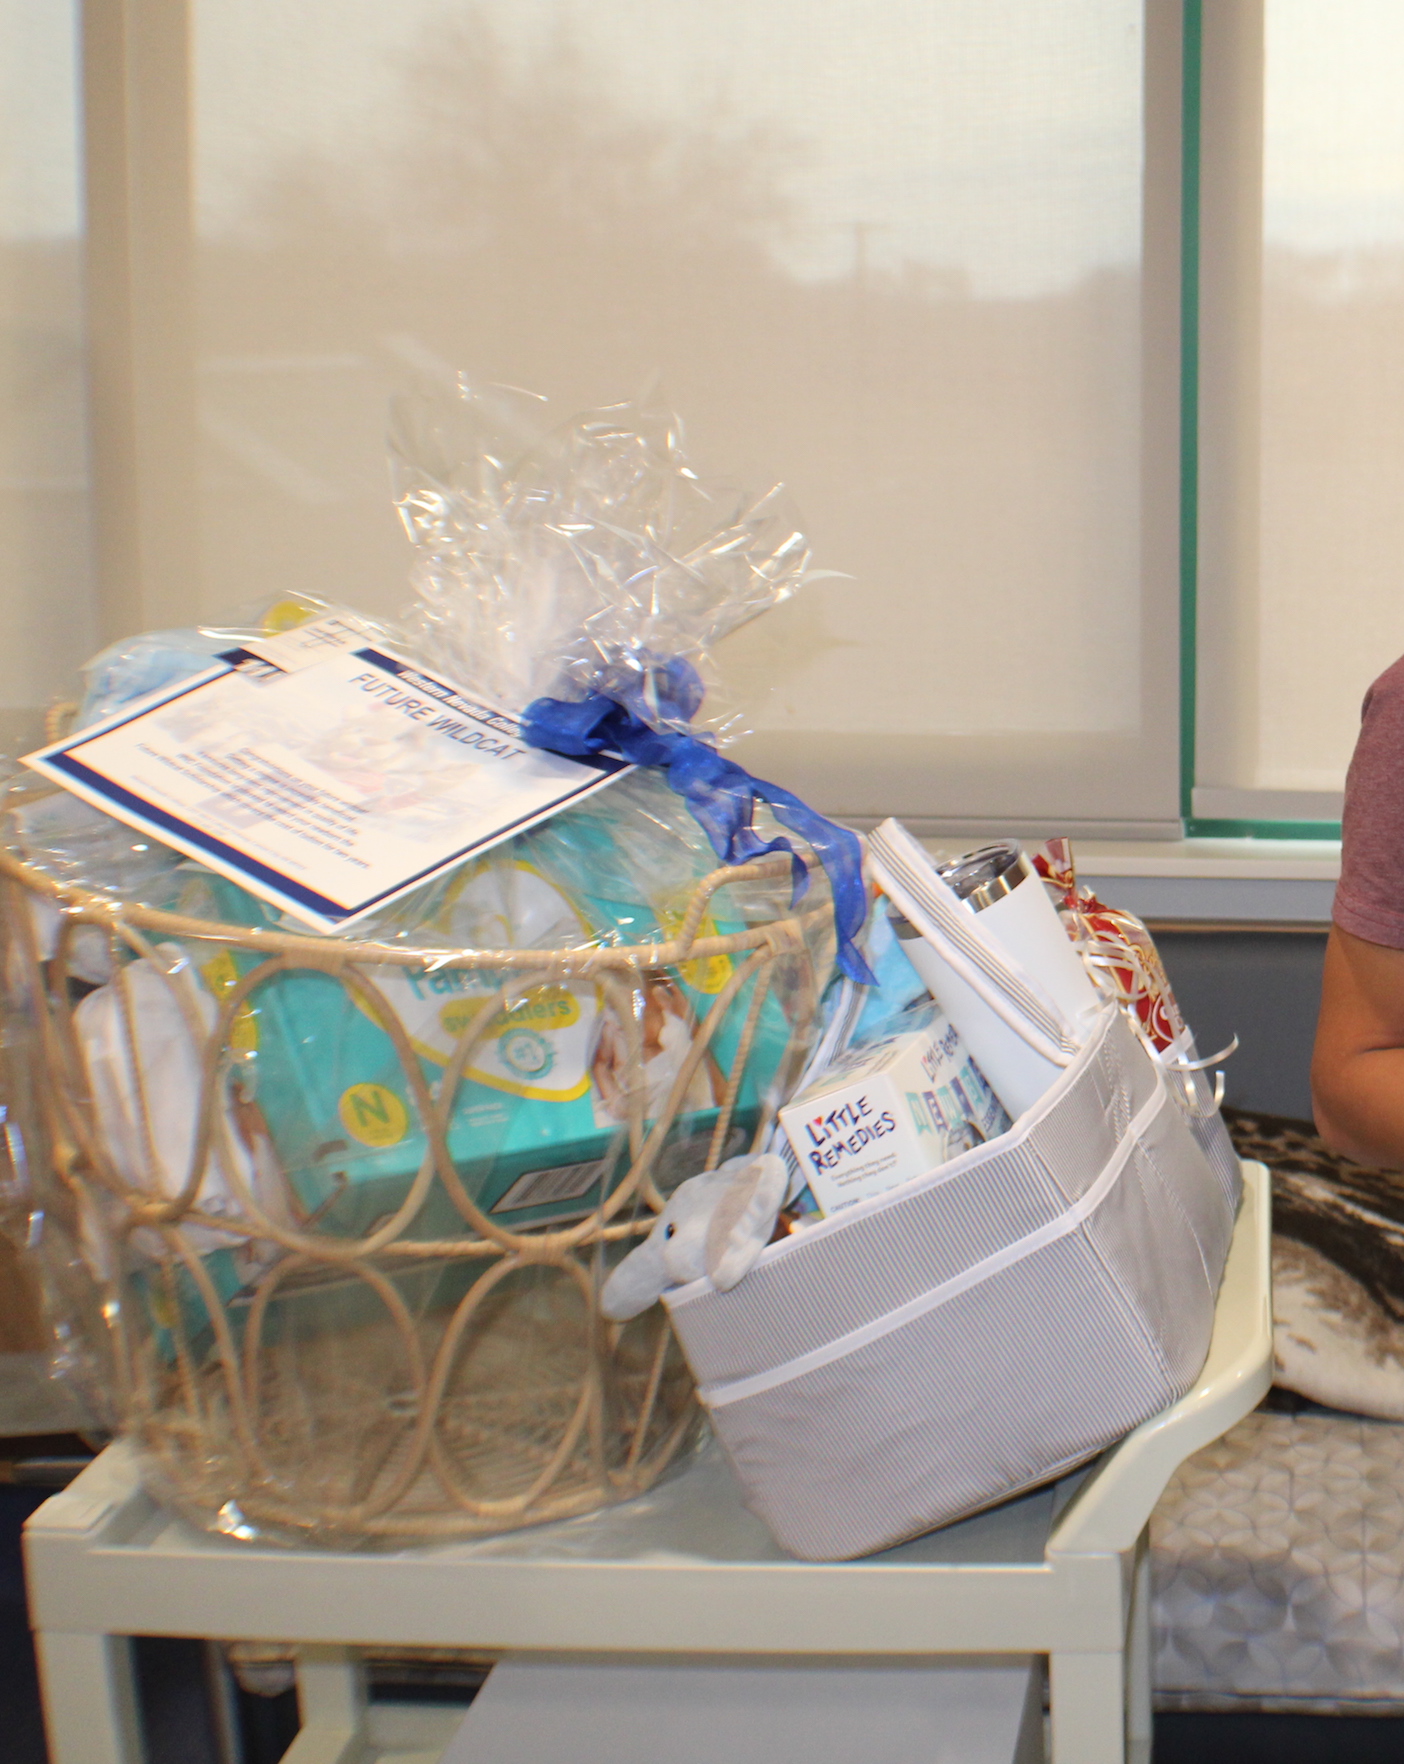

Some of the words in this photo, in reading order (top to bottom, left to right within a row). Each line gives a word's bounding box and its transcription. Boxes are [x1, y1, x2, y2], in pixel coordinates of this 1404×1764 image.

[347, 672, 439, 722] FUTURE
[429, 714, 526, 760] WILDCAT
[392, 668, 454, 697] Western
[438, 693, 496, 721] Nevada
[349, 1089, 390, 1127] N
[807, 1111, 897, 1176] REMEDIES
